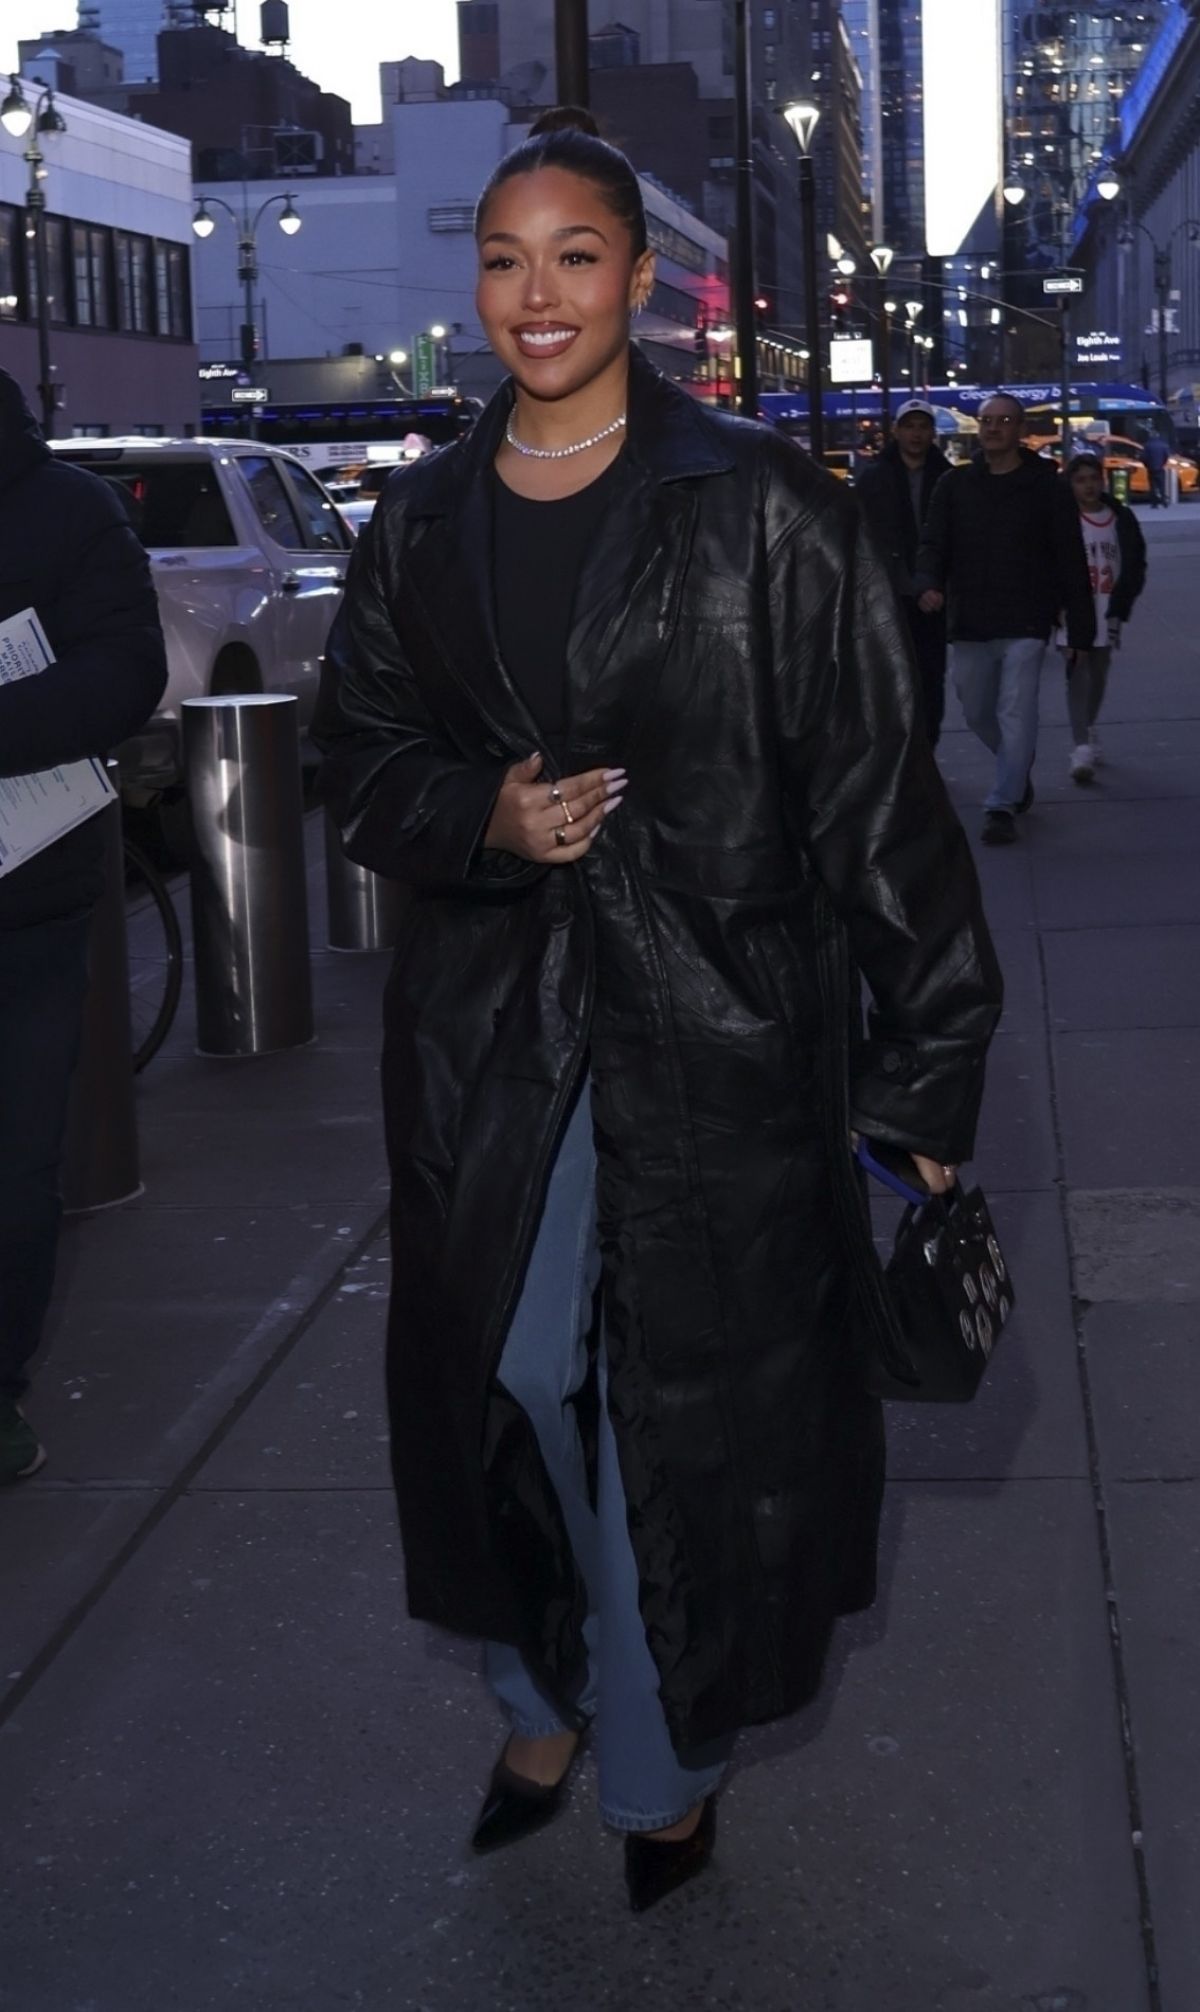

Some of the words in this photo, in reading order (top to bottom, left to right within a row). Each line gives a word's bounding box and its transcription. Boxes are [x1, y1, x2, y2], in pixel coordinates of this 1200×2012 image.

[1076, 336, 1103, 348] Eighth
[1103, 336, 1120, 345] Ave
[198, 368, 222, 379] Eighth
[1050, 386, 1078, 398] bs
[2, 636, 27, 677] PRIORIT
